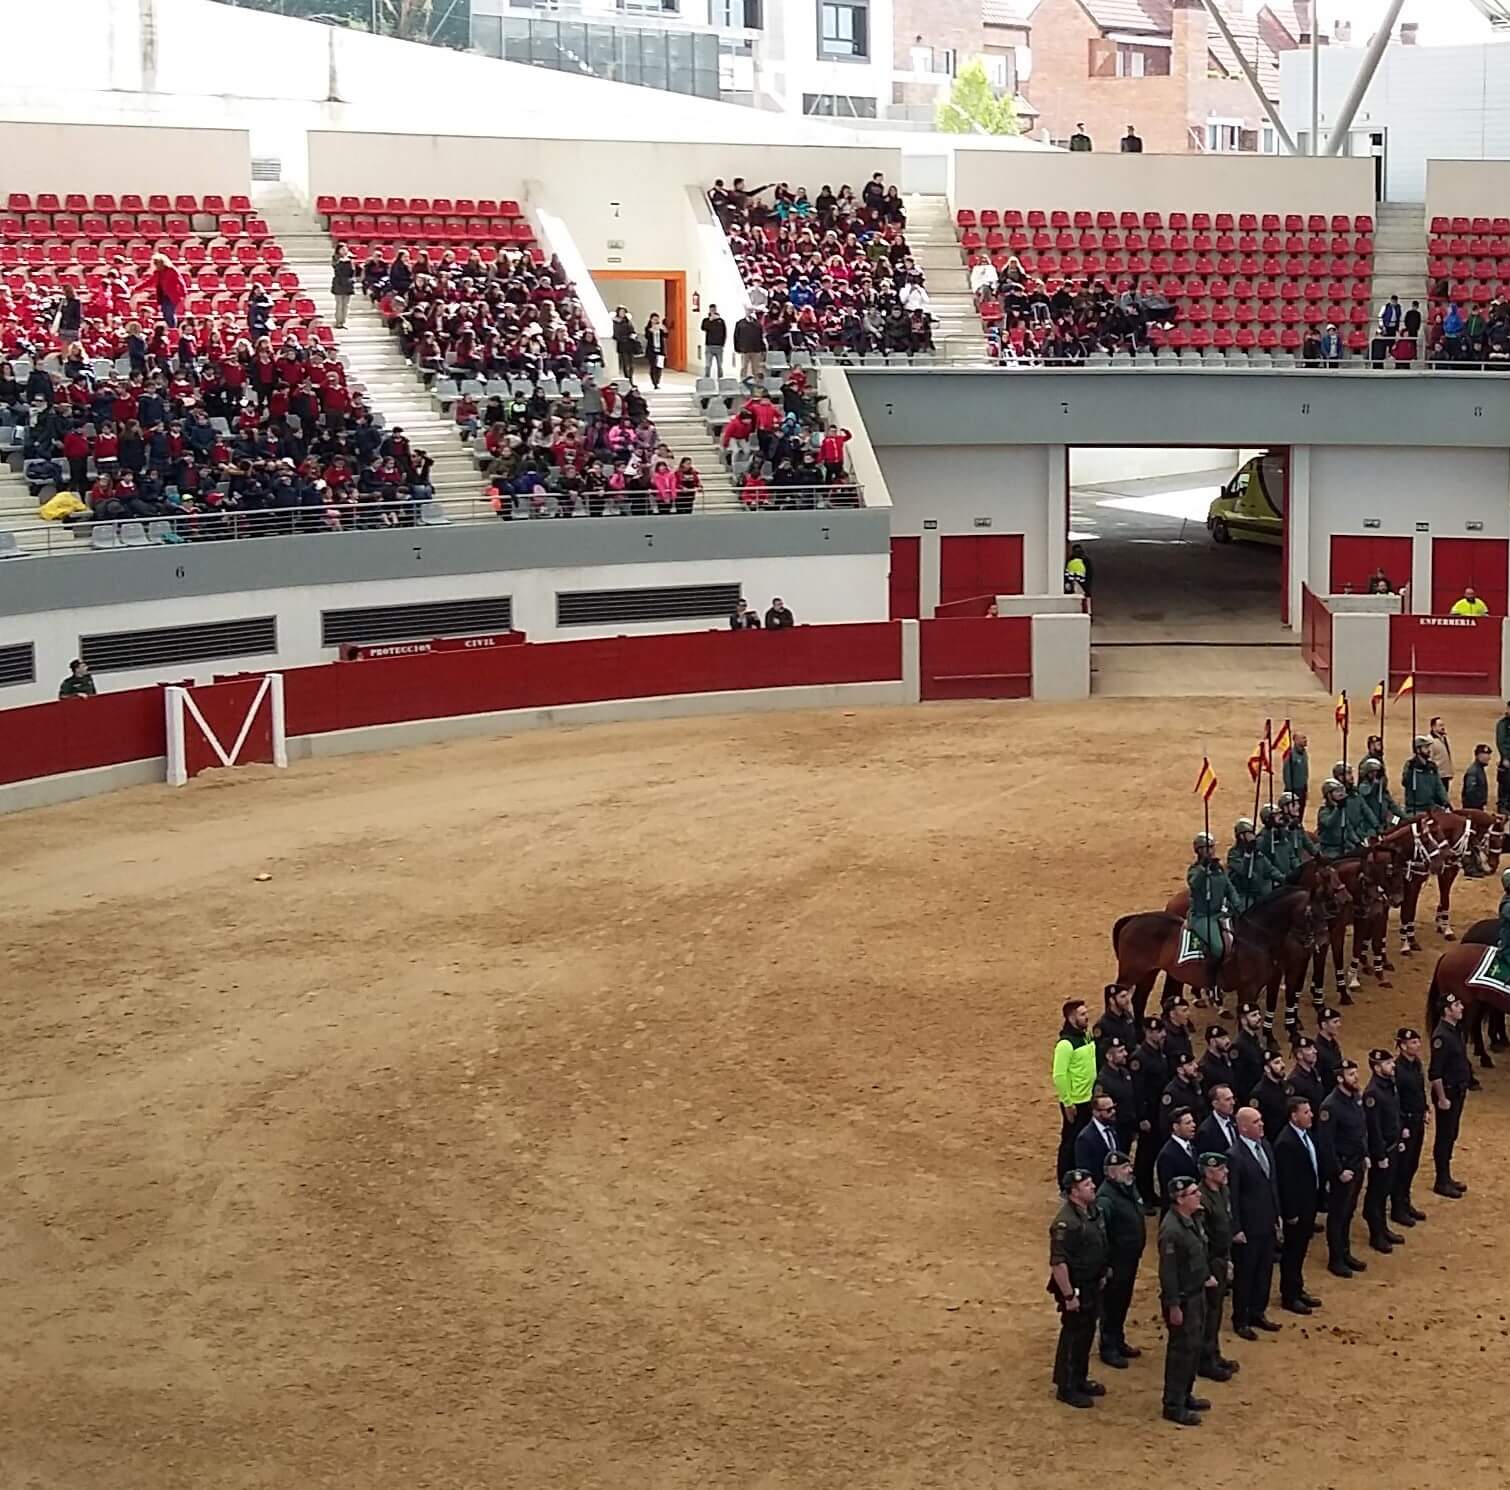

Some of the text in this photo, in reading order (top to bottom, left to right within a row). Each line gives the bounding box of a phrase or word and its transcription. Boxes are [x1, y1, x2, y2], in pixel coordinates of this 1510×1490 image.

[610, 203, 620, 219] 7
[1301, 403, 1311, 415] 8
[1473, 406, 1482, 417] 8
[176, 565, 185, 579] 6
[1420, 617, 1477, 627] ENFERMERIA
[370, 638, 495, 657] PROTECCION CIVIL
